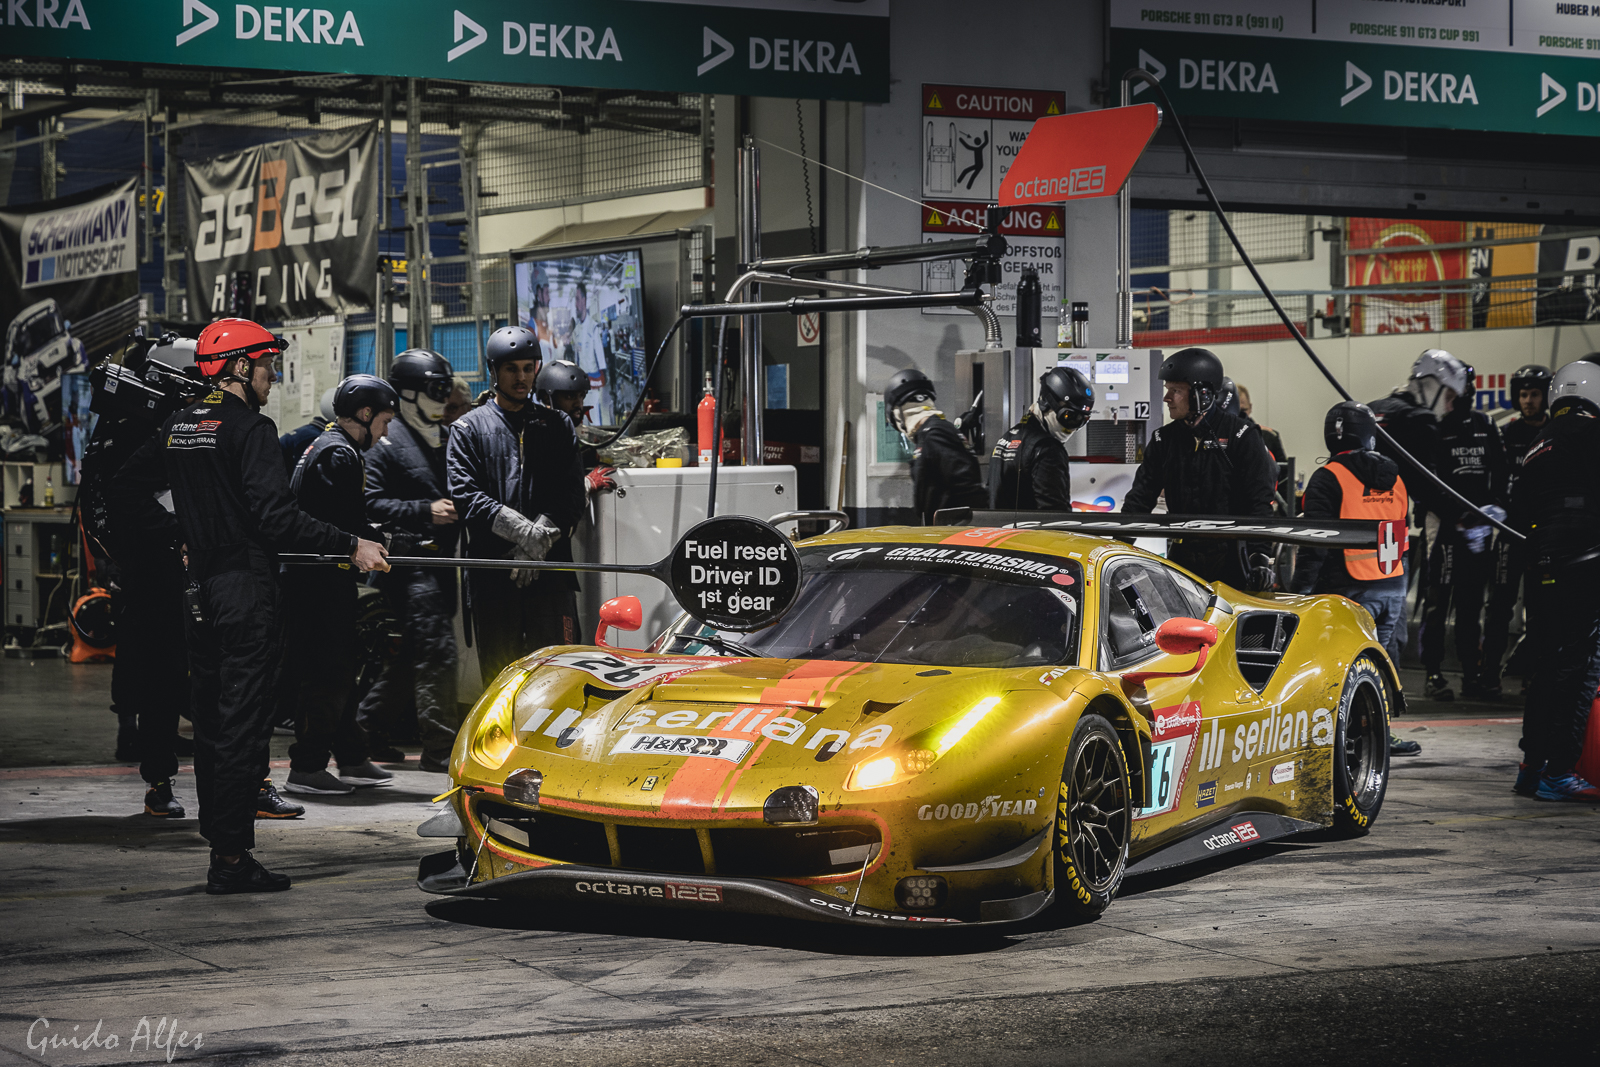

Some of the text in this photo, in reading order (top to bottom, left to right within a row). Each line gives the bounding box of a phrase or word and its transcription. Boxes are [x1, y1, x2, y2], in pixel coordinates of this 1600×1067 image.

[1141, 9, 1284, 32] PORSCHE 911 GT3 R (991 II)
[1555, 2, 1589, 16] HUBER
[235, 3, 364, 47] DEKRA
[1350, 22, 1479, 42] PORSCHE 911 GT3 CUP 991
[502, 20, 623, 61] DEKRA
[1539, 35, 1584, 49] PORSCHE
[748, 37, 862, 75] DEKRA
[1179, 58, 1279, 94] DEKRA
[1384, 70, 1479, 104] DEKRA
[956, 94, 1033, 113] CAUTION
[996, 145, 1021, 156] YOU
[1014, 165, 1107, 199] octane126
[947, 208, 1042, 229] ACHUNG
[56, 244, 126, 278] MOTORSPORT
[1004, 246, 1062, 259] OPFSTOß
[1003, 262, 1053, 274] GEFAHR
[211, 259, 332, 313] RCING
[996, 303, 1009, 311] des
[1135, 402, 1150, 417] 12
[685, 540, 787, 561] Fuel reset
[886, 547, 1059, 575] GRAN TURISMO
[690, 565, 781, 586] Driver ID
[935, 558, 980, 567] DRIVING
[982, 563, 1046, 580] SIMULATOR
[697, 589, 775, 614] 1st gear
[570, 656, 656, 683] 26
[617, 707, 893, 753] serliana
[1231, 704, 1335, 764] serliana
[630, 735, 694, 752] H&R
[1197, 786, 1216, 799] HAZET
[917, 796, 1037, 822] GOODYEAR
[1345, 794, 1368, 828] EAGLE
[1203, 821, 1260, 851] octane126
[575, 881, 722, 902] octane126
